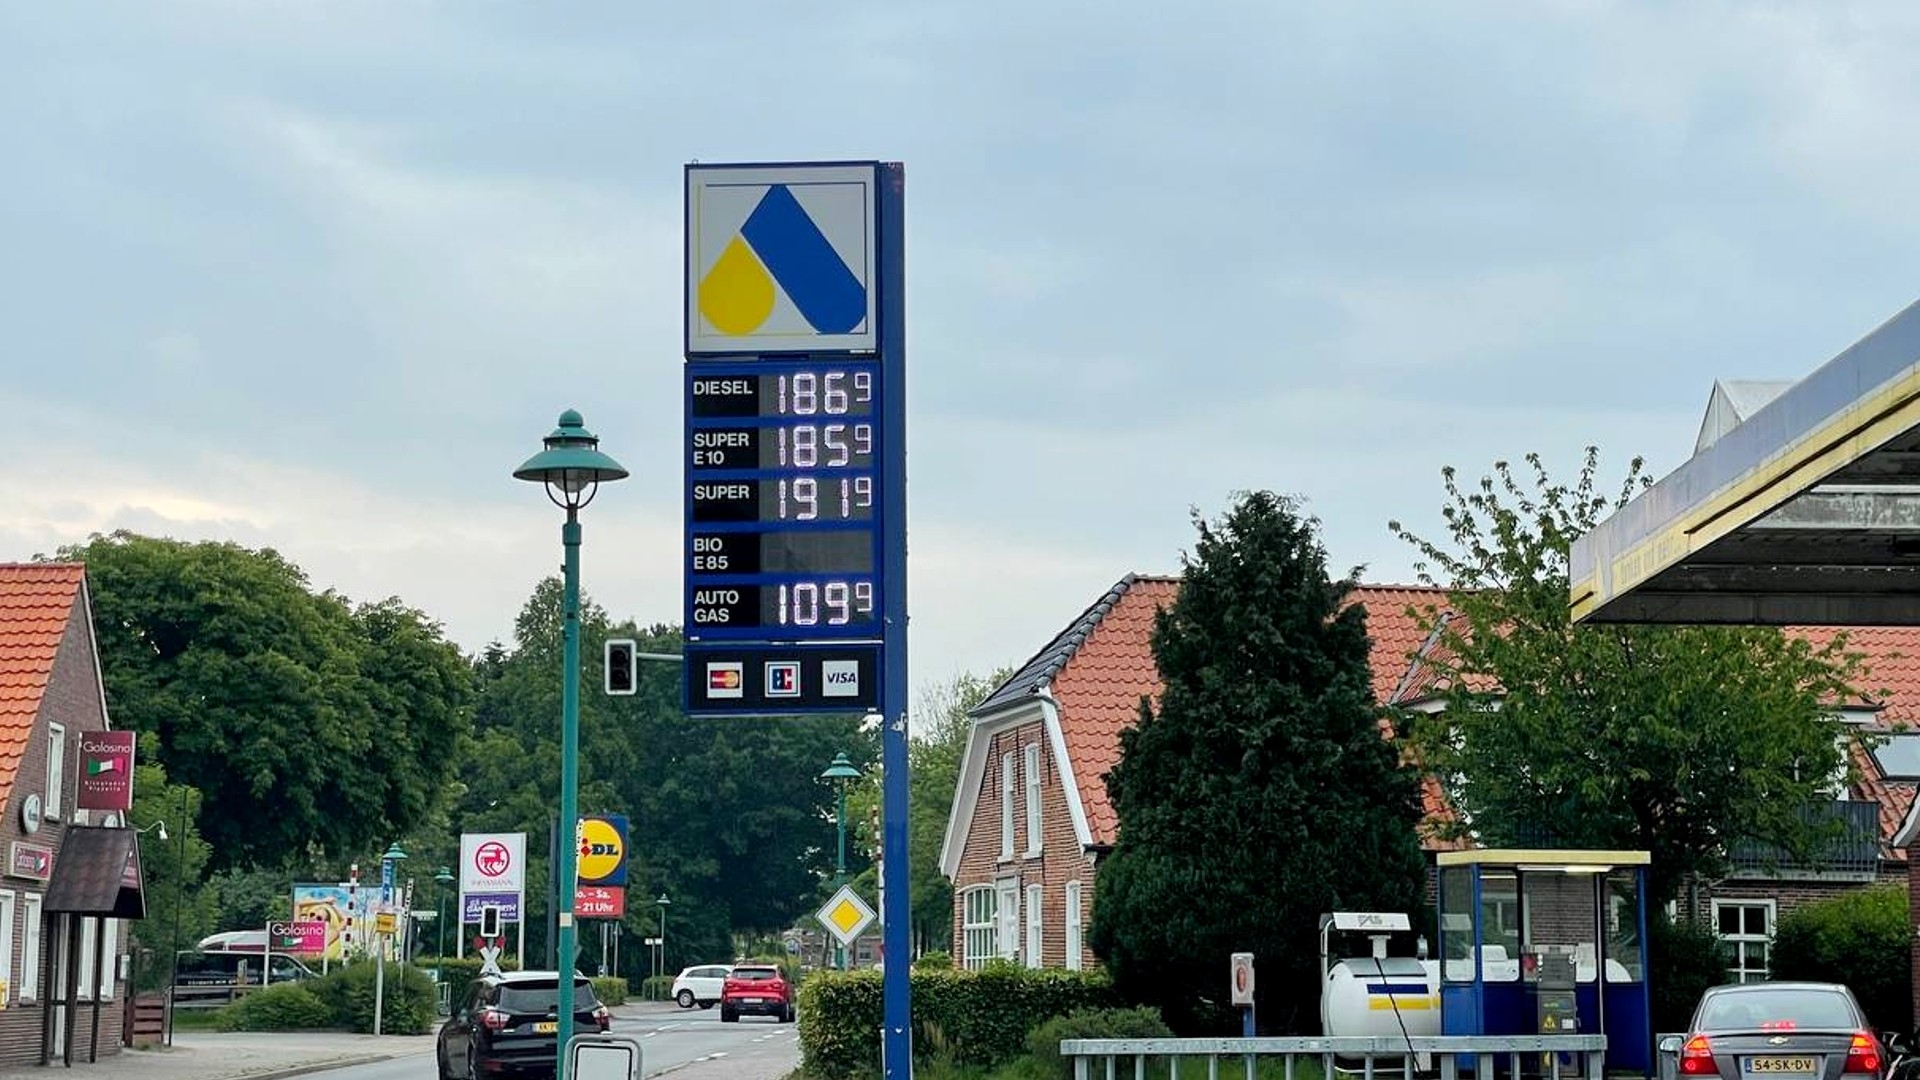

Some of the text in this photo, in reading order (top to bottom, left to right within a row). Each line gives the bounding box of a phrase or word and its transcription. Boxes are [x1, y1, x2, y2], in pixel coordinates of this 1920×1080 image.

[693, 381, 753, 395] DIESEL
[693, 432, 750, 448] SUPER
[693, 450, 725, 465] E10
[693, 485, 750, 500] SUPER
[693, 537, 723, 552] BIO
[694, 590, 740, 605] AUTO
[693, 607, 730, 623] GAS
[827, 672, 856, 684] VISA
[271, 923, 324, 936] Golosino
[1754, 1059, 1812, 1071] 54-SK-DV
